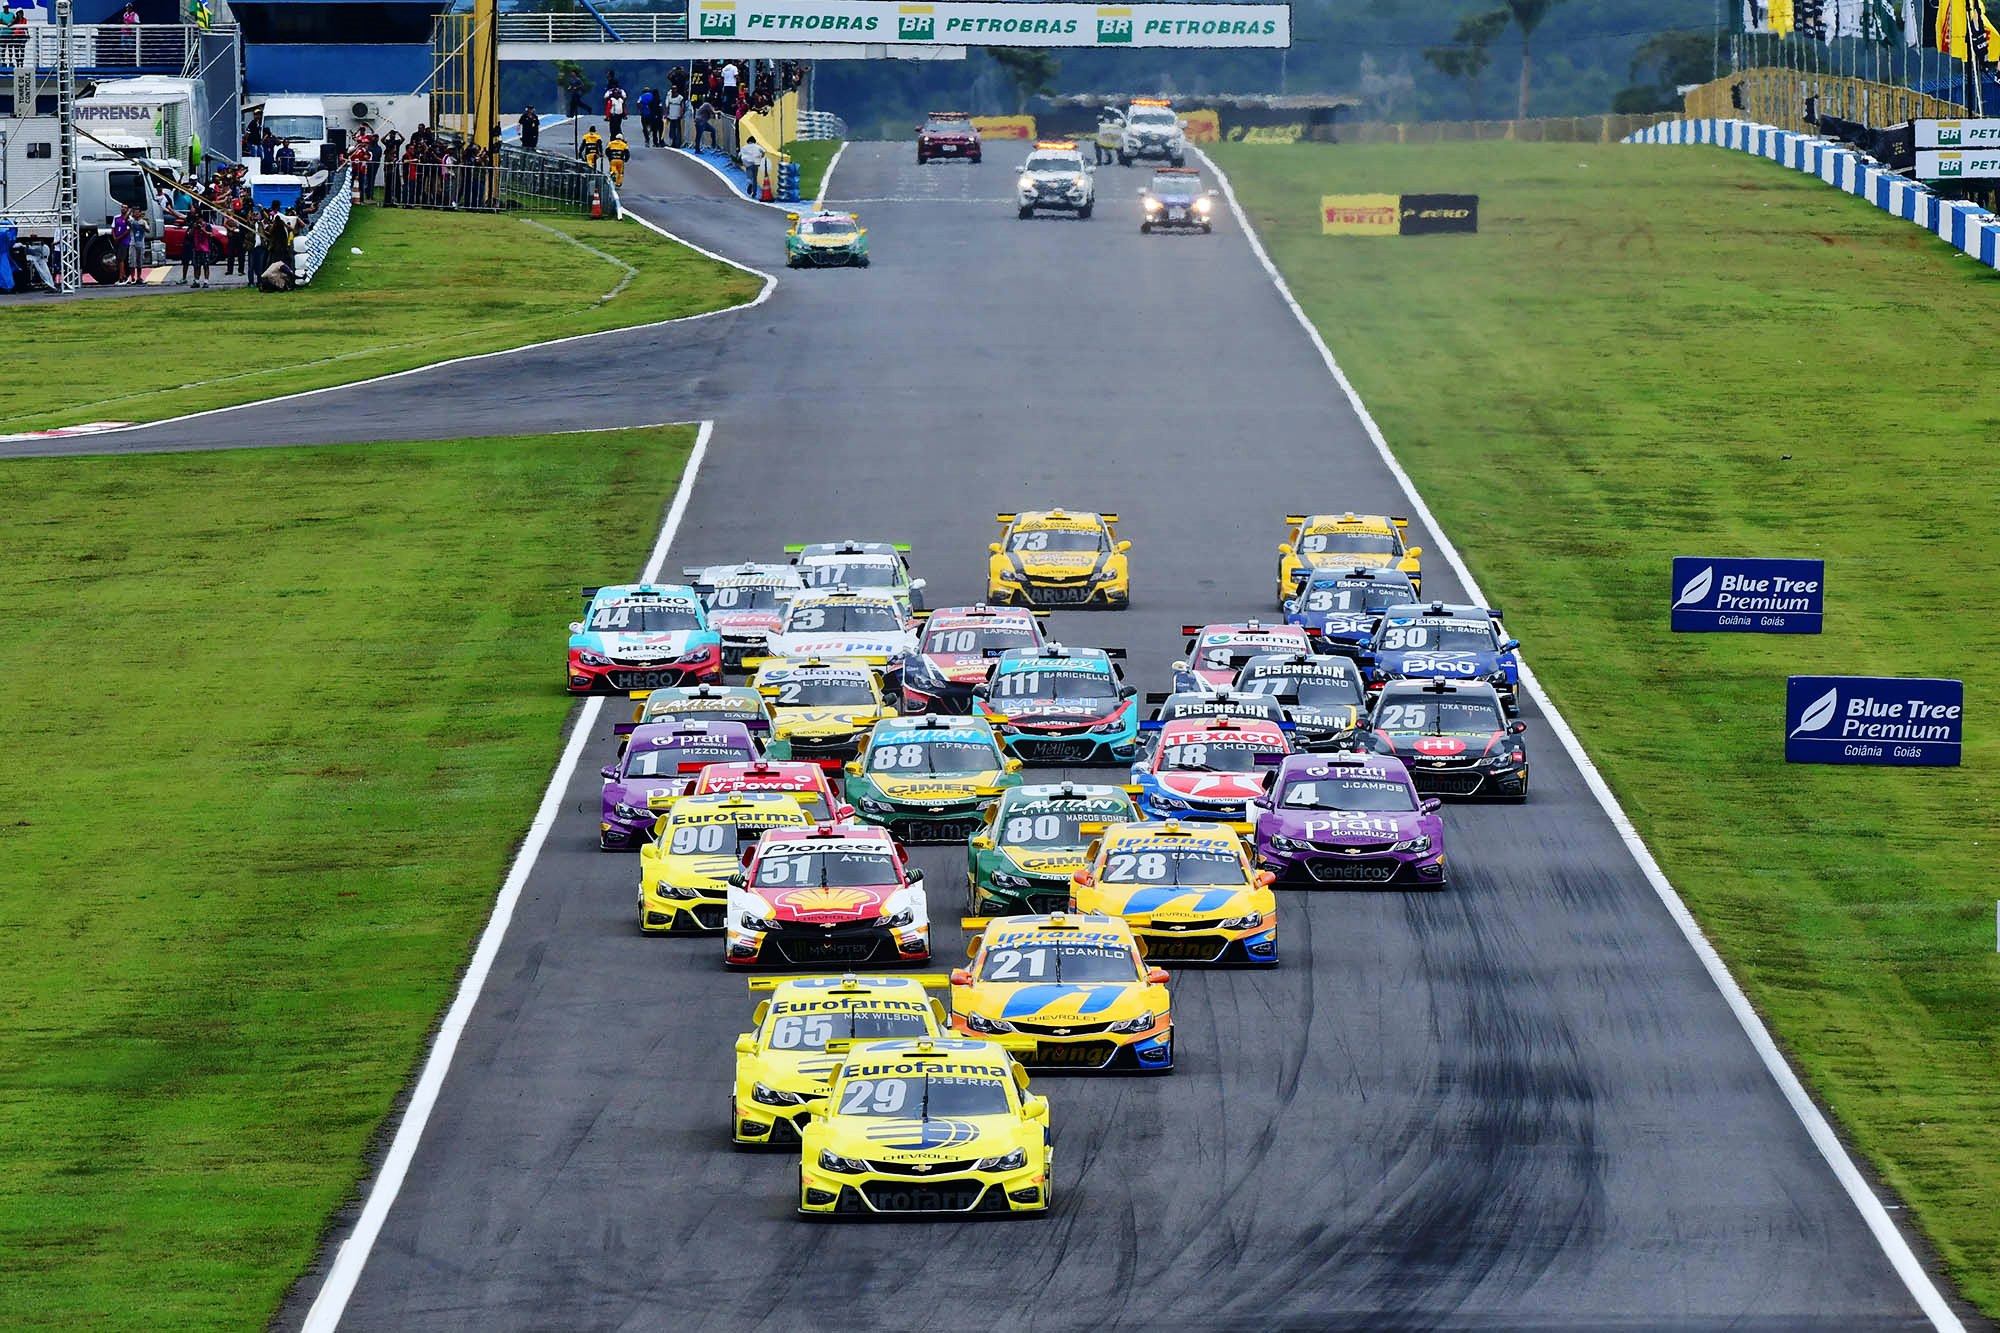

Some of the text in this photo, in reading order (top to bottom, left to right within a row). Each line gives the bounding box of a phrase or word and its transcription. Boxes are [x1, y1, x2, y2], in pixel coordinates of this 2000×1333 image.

[703, 14, 879, 30] BR PETROBRAS
[901, 17, 1077, 33] BR PETROBRAS
[1101, 19, 1276, 35] BR PETROBRAS
[1940, 128, 2000, 140] BR PET
[1940, 160, 2000, 171] BR PET
[1012, 531, 1049, 551] 73
[1302, 534, 1328, 553] 9
[1720, 574, 1819, 593] Blue Tree
[624, 597, 689, 605] HERO
[1308, 590, 1352, 612] 31
[1716, 593, 1810, 610] Premium
[591, 607, 631, 629] 44
[792, 608, 826, 630] 3
[1718, 615, 1785, 626] Goiânia Goiás
[931, 630, 977, 653] 110
[1233, 633, 1300, 645] Cifarma
[1385, 627, 1428, 649] 30
[618, 644, 672, 653] HERO
[618, 671, 673, 688] HERO
[792, 668, 862, 677] Cifarma
[1043, 671, 1110, 681] BARRICHELLO
[1254, 665, 1345, 679] EISENBAHN
[802, 679, 870, 688] L.FORESTI
[997, 671, 1040, 696] 111
[1247, 678, 1289, 696] 77
[651, 698, 745, 712] LAVITAN
[1001, 697, 1098, 709] Mobil
[1174, 703, 1269, 718] EISENBAHN
[1846, 697, 1961, 719] Blue Tree
[1380, 704, 1426, 729] 25
[1842, 718, 1951, 739] Premium
[680, 734, 728, 747] prati
[1168, 732, 1281, 745] TEXACO
[682, 748, 742, 756] PIZZONIA
[1164, 744, 1207, 768] 18
[1212, 743, 1284, 754] KHODAIR
[1844, 744, 1922, 758] Goiânia Goiás
[636, 751, 659, 775] 1
[873, 744, 923, 770] 88
[709, 776, 745, 784] Shell
[1335, 766, 1386, 779] prati
[708, 781, 805, 792] V-Power
[1285, 782, 1320, 806] 4
[1342, 781, 1404, 793] J.CAMPOS
[1008, 799, 1113, 813] LAVITAN
[672, 811, 804, 826] Eurofarma
[1065, 814, 1100, 822] MARCOS
[1006, 815, 1061, 843] 80
[1304, 817, 1399, 839] prati
[1331, 829, 1399, 840] donaduzzi
[670, 825, 725, 855] 90
[1117, 836, 1229, 848] Ipiranga
[764, 843, 888, 855] Pioneer
[1171, 852, 1235, 863] GALID
[761, 855, 812, 884] 51
[1107, 852, 1167, 882] 28
[1151, 911, 1207, 919] HEVROLET
[997, 931, 1119, 943] Ipiranga
[1053, 947, 1125, 959] T.CAMILO
[991, 948, 1046, 980] 21
[773, 998, 928, 1014] Eurofarma
[843, 1012, 920, 1022] MAX WILSON
[1027, 1015, 1099, 1023] CHEVROLET
[772, 1015, 833, 1049] 65
[843, 1060, 1007, 1078] Eurofarma
[927, 1077, 1002, 1088] D.SERRA
[839, 1078, 907, 1115] 29
